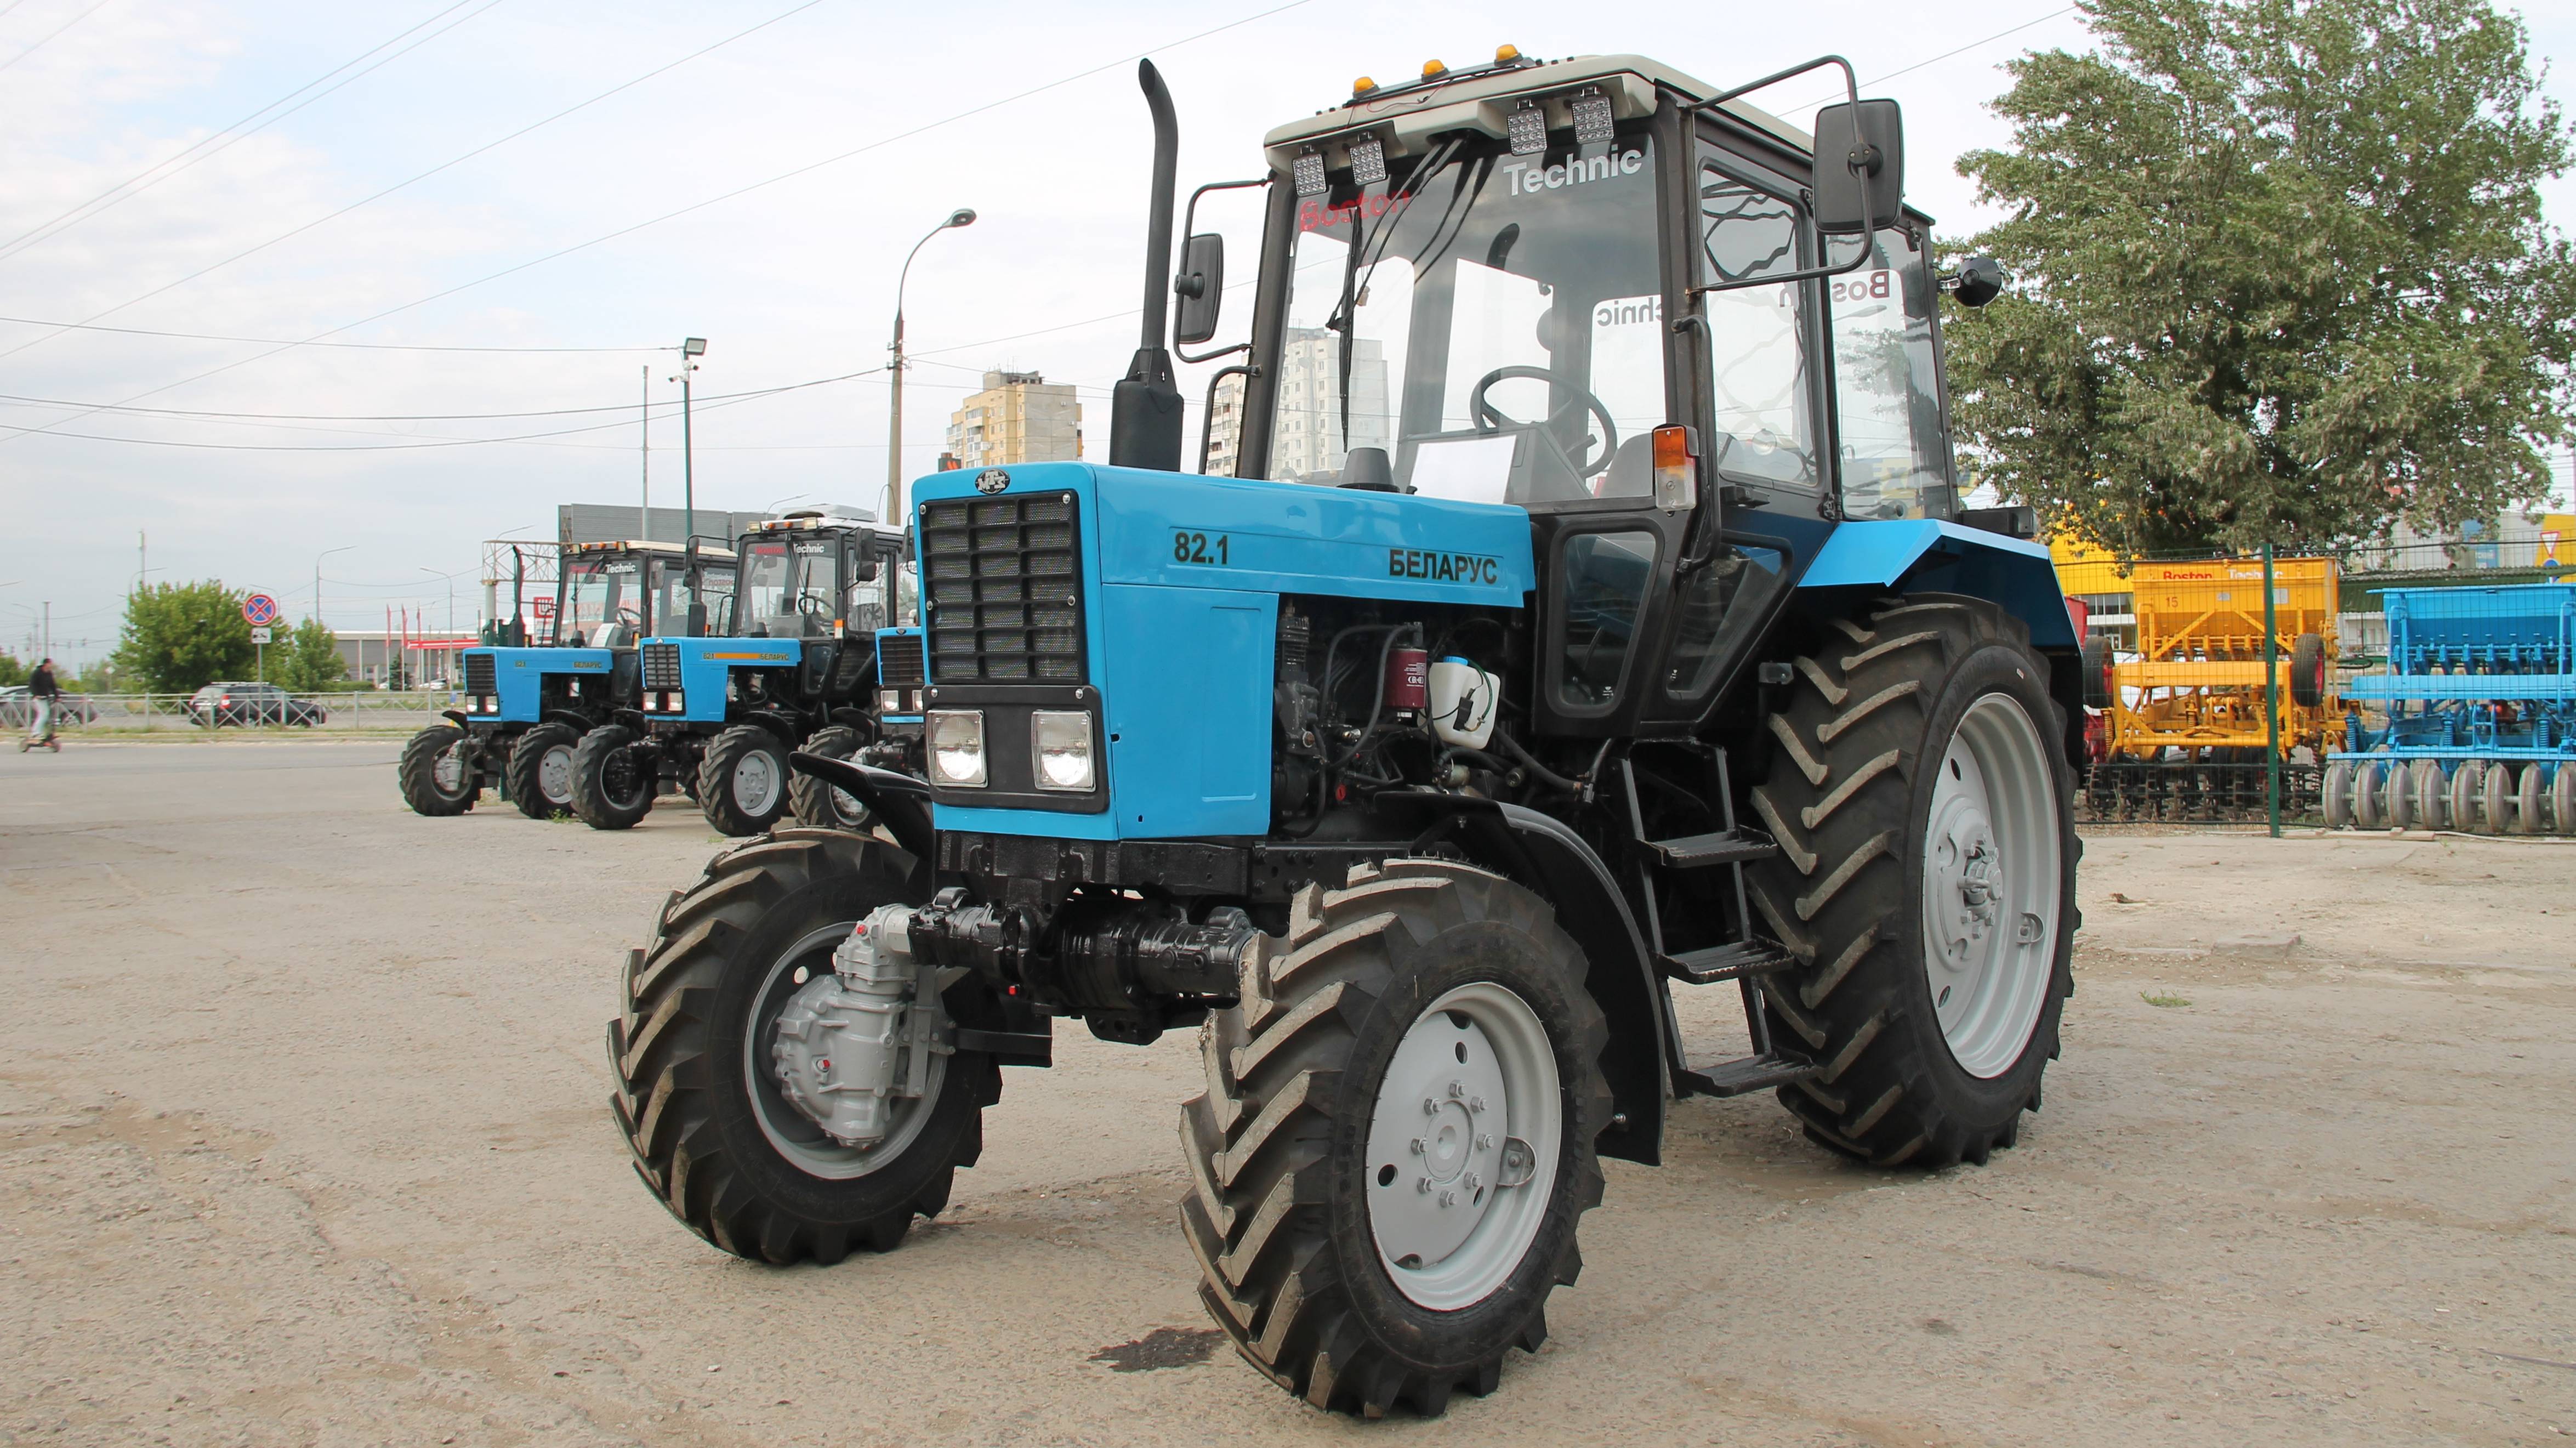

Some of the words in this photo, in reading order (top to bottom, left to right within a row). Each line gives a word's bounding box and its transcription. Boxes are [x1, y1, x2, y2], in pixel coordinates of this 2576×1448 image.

[1299, 190, 1411, 231] Boston
[1503, 144, 1642, 196] Technic
[793, 543, 824, 553] Technic
[1174, 532, 1228, 565] 82.1
[1389, 549, 1498, 584] БЕЛАРУС
[605, 563, 636, 573] Technic
[2228, 569, 2283, 579] Techic
[2166, 597, 2178, 607] 15
